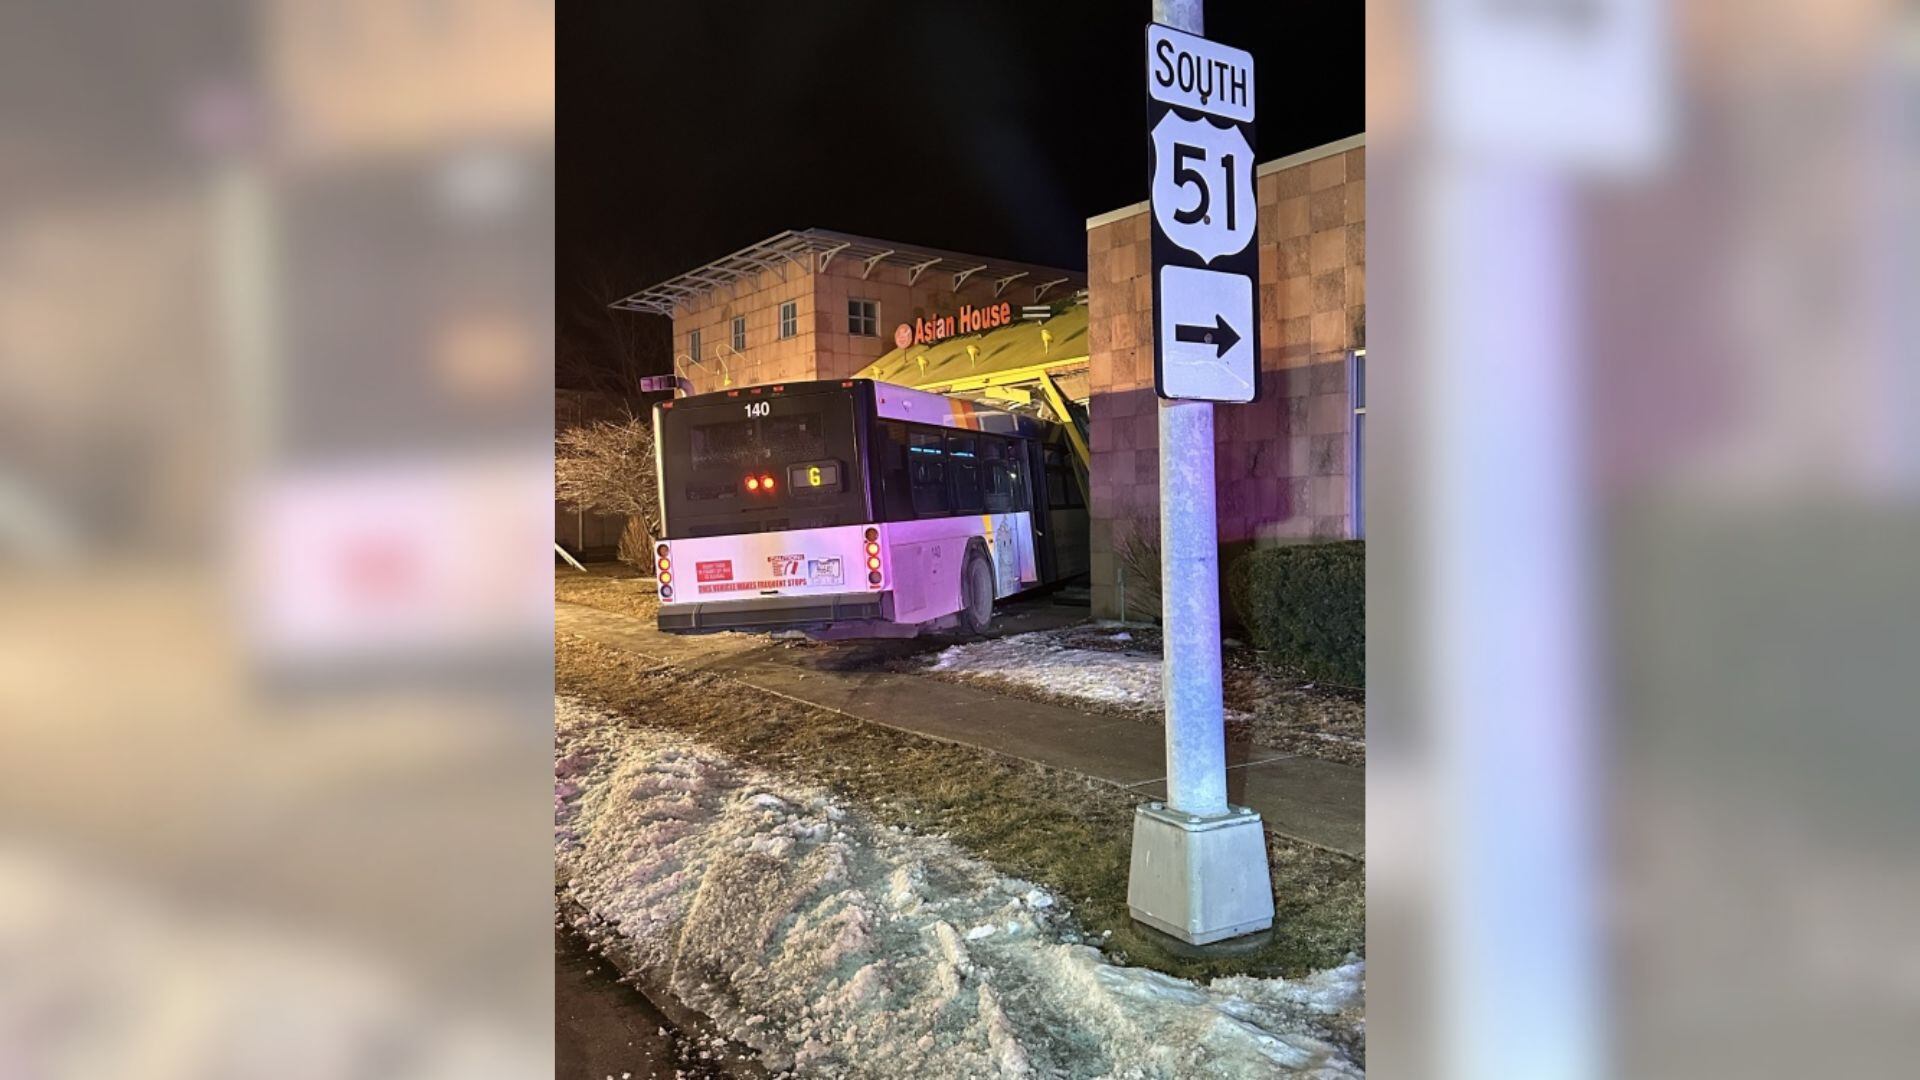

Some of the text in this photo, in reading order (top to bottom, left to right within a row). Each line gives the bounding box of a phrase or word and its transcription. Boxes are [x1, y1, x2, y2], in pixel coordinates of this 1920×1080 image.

[1155, 38, 1247, 108] SOUTH
[1173, 142, 1236, 231] 51
[914, 301, 1012, 344] Asian House
[744, 401, 770, 418] 140
[712, 582, 736, 592] VEHICLE
[736, 581, 757, 591] MAKES
[757, 579, 786, 589] FREQUENT
[787, 578, 807, 588] STOPS
